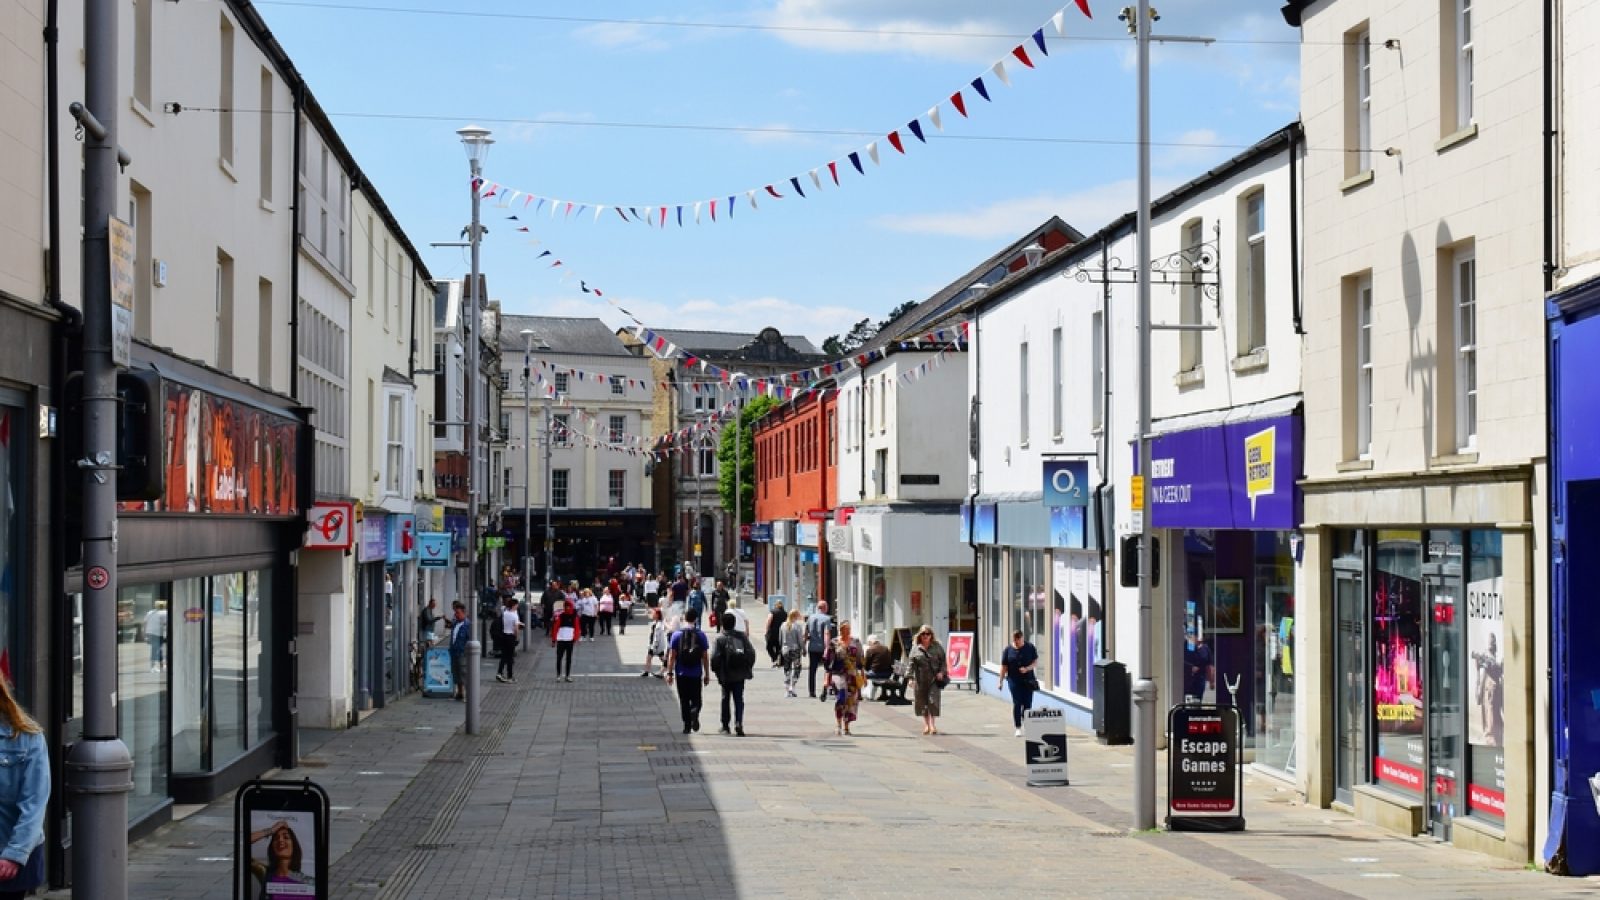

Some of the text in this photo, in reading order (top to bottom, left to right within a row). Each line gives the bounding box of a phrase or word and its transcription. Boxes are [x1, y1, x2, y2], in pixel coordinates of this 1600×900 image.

[1248, 446, 1262, 463] GEEK
[1249, 461, 1271, 481] RETREAT
[1179, 483, 1192, 503] OUT
[1181, 738, 1228, 756] Escape
[1181, 758, 1226, 773] Games
